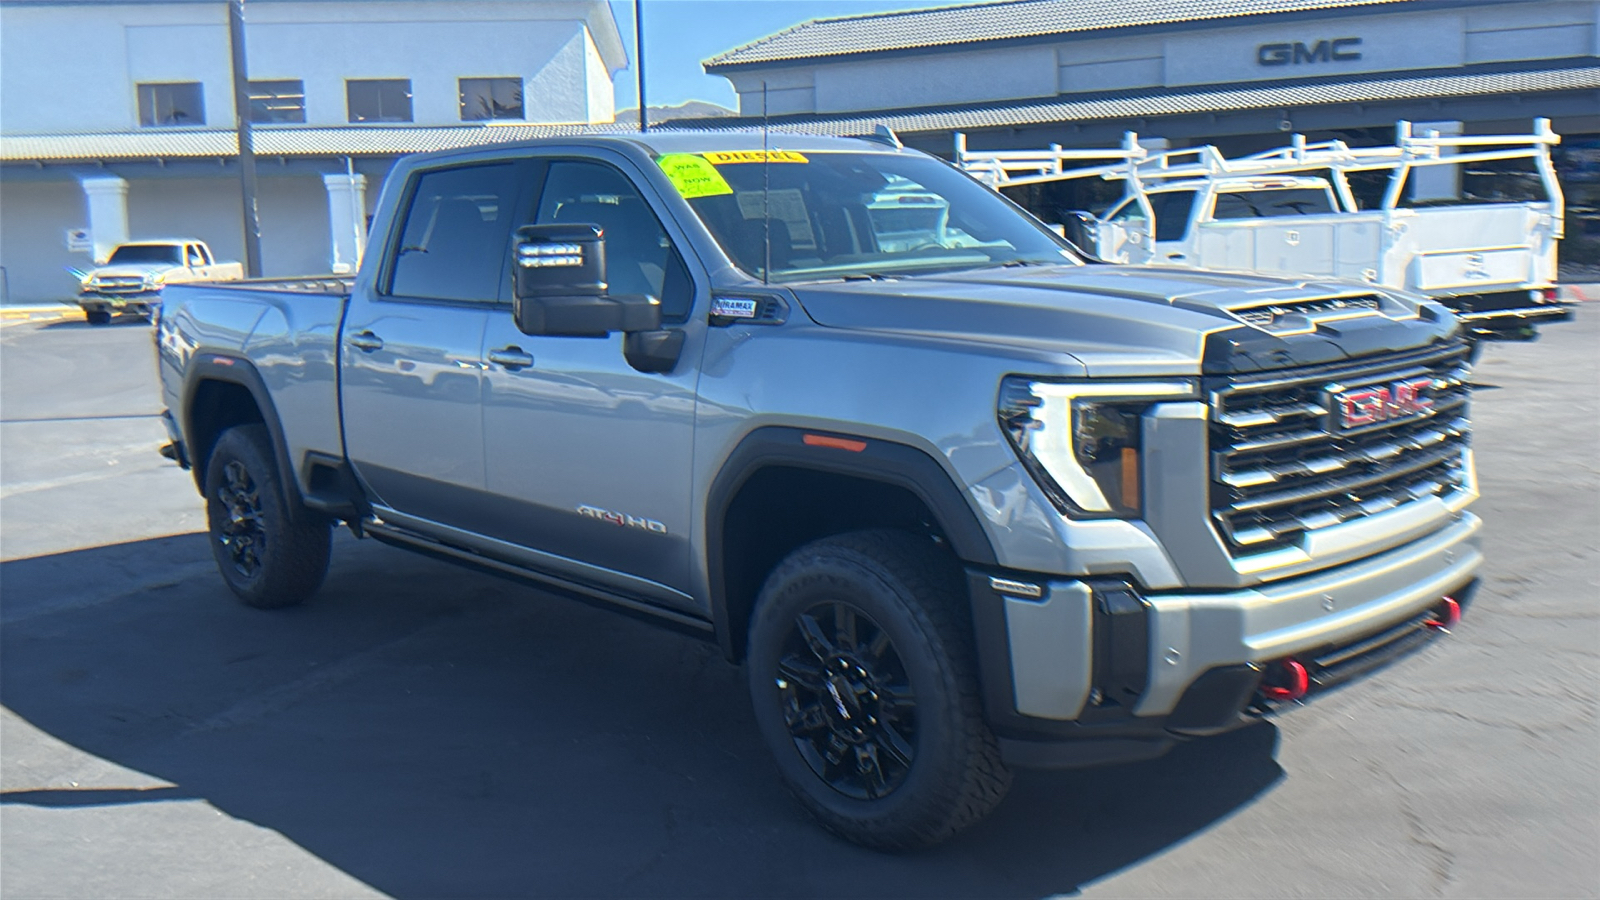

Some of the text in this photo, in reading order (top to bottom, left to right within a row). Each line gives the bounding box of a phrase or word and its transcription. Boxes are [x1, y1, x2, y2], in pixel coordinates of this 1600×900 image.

[1258, 37, 1363, 66] GMC
[717, 152, 798, 161] DIESEL
[1342, 379, 1434, 425] GMC
